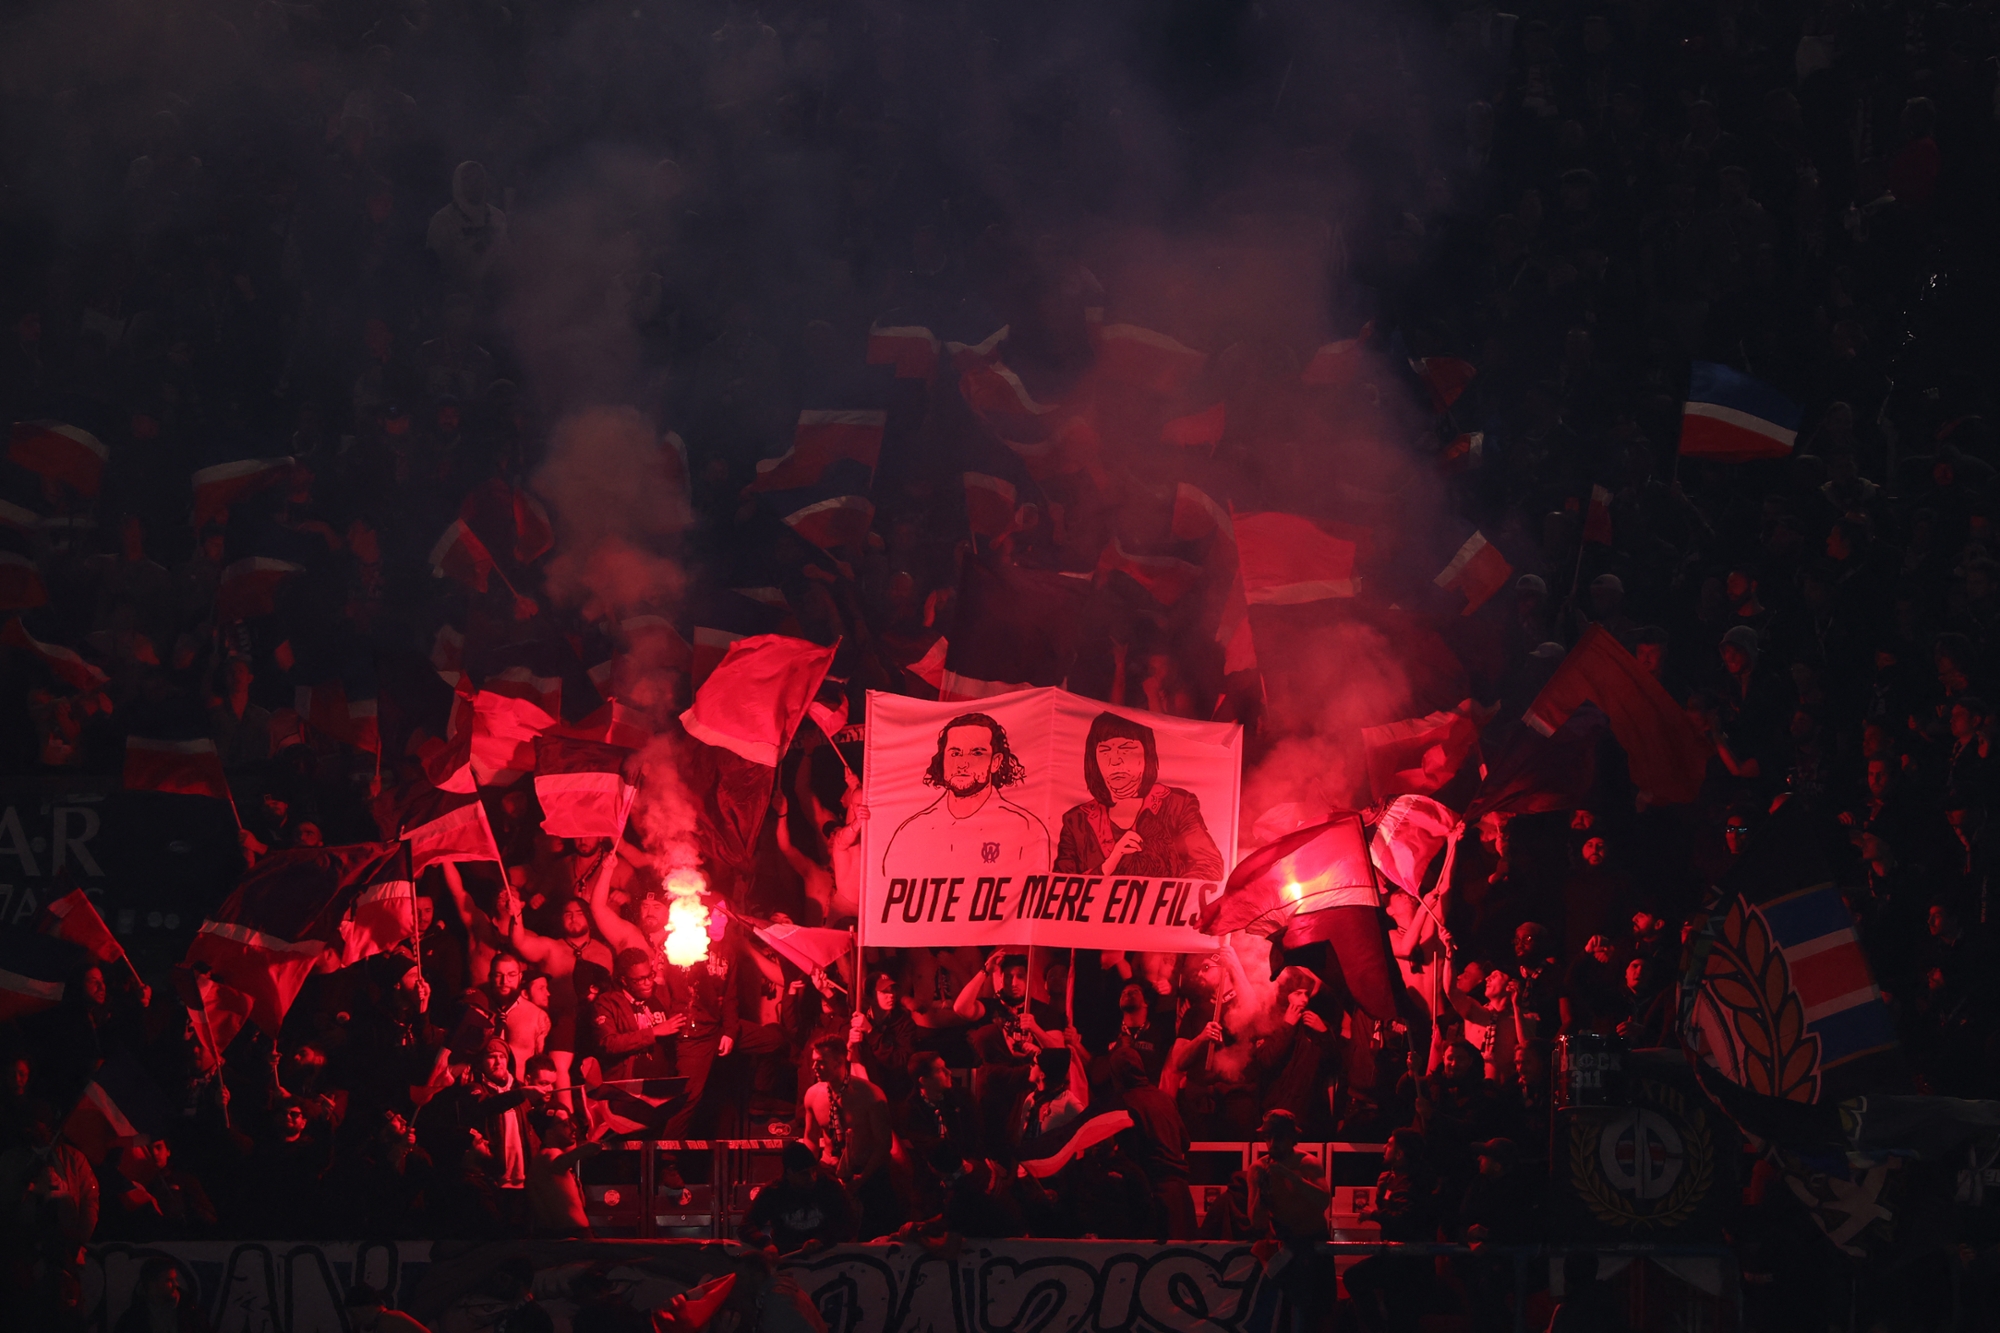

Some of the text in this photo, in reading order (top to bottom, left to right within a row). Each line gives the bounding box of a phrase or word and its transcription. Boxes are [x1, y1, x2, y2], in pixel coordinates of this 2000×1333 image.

[881, 876, 965, 924] PUTE
[968, 876, 1012, 923] DE
[1016, 874, 1102, 923] MERE
[1103, 878, 1149, 924] EN
[1570, 1070, 1603, 1089] 311
